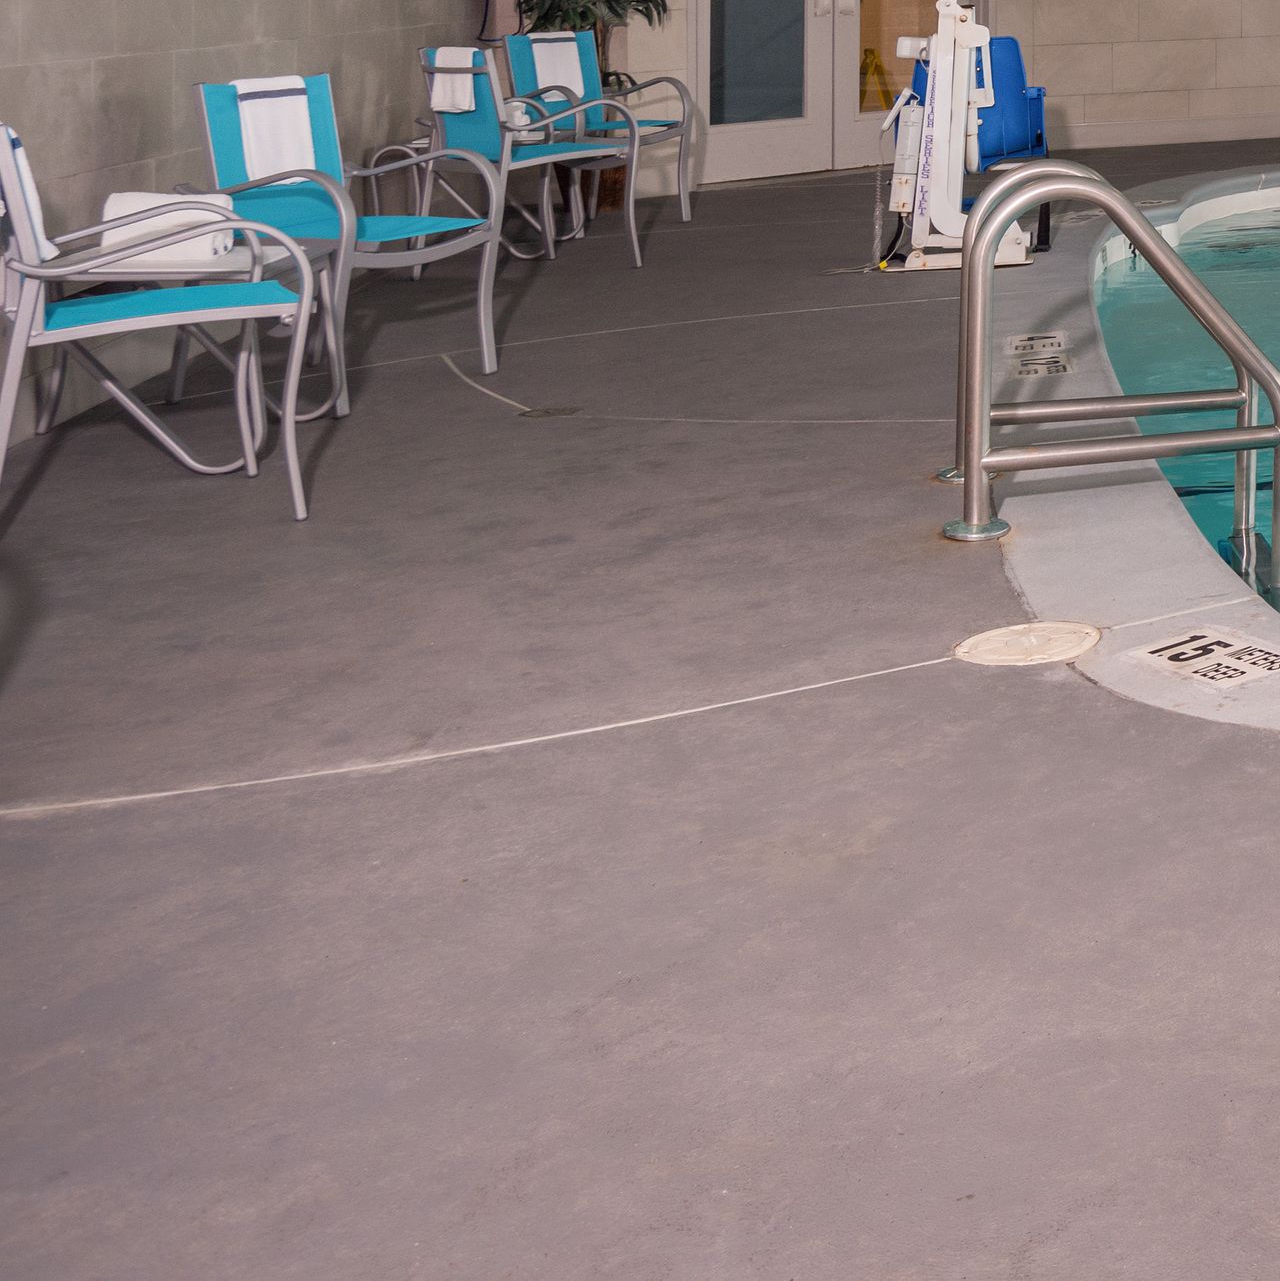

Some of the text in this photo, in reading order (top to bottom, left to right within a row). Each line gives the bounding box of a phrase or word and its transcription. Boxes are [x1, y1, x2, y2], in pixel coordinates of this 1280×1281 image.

[921, 134, 934, 179] SERIES
[918, 185, 929, 216] LIFT
[1192, 662, 1248, 682] DEEP
